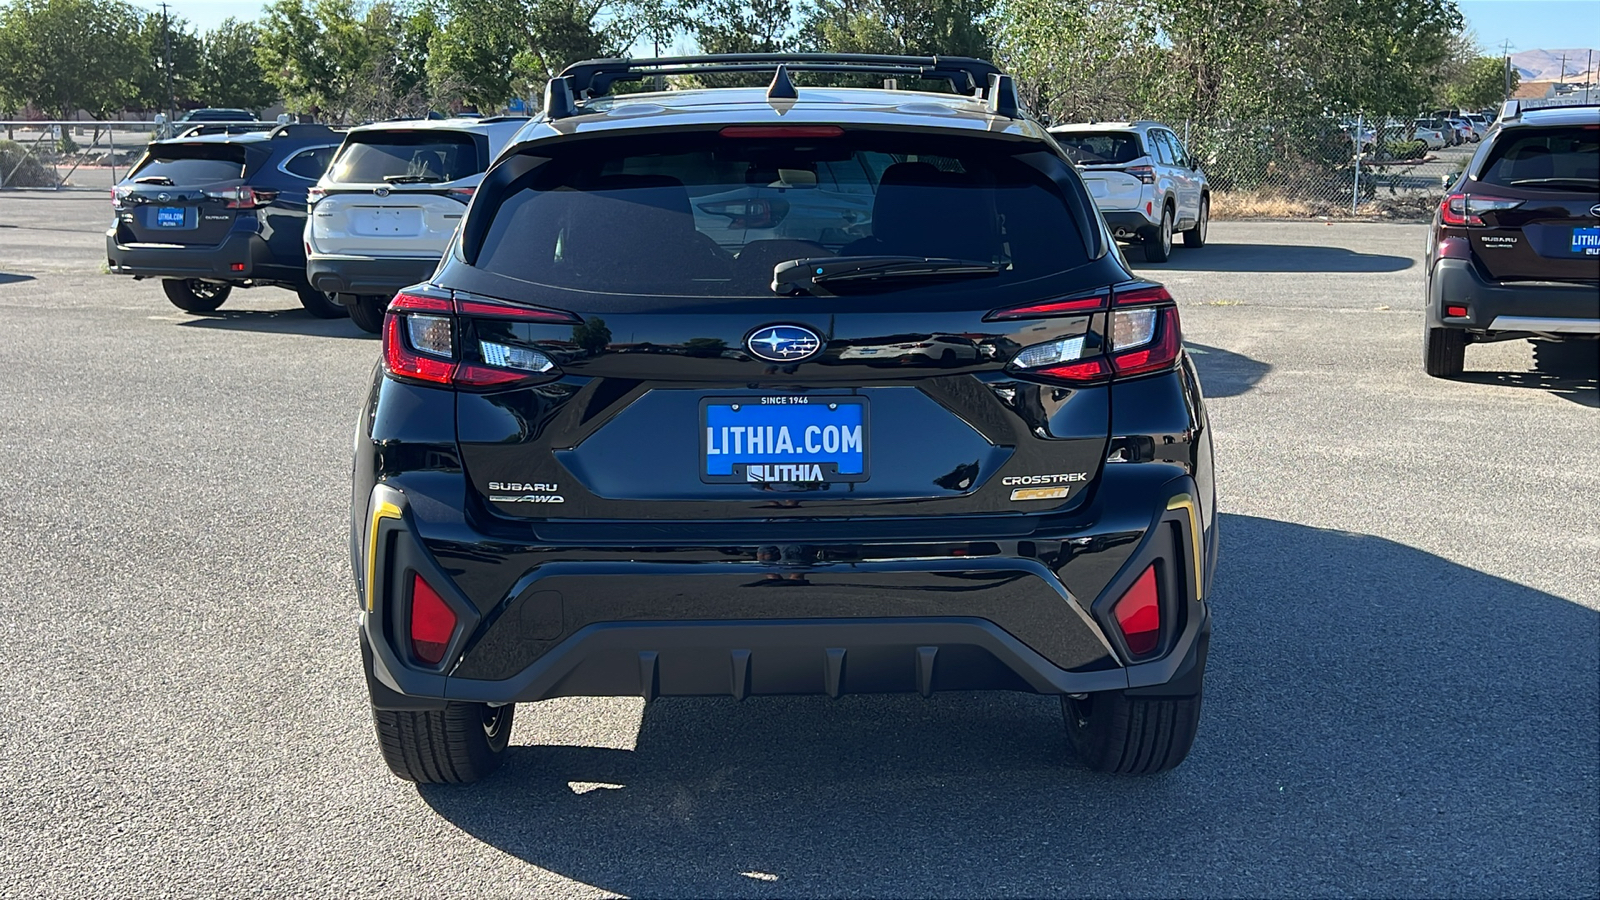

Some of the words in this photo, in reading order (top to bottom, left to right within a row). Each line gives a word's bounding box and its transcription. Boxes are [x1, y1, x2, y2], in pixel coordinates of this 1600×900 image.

[158, 213, 183, 221] LITHIA.COM
[761, 396, 787, 404] SINCE
[789, 396, 808, 404] 1946
[707, 425, 862, 455] LITHIA.COM
[764, 464, 824, 481] LITHIA
[1002, 472, 1087, 485] CROSSTREK
[488, 482, 558, 492] SUBARU
[1014, 486, 1066, 499] SPORT
[517, 495, 565, 503] AWD
